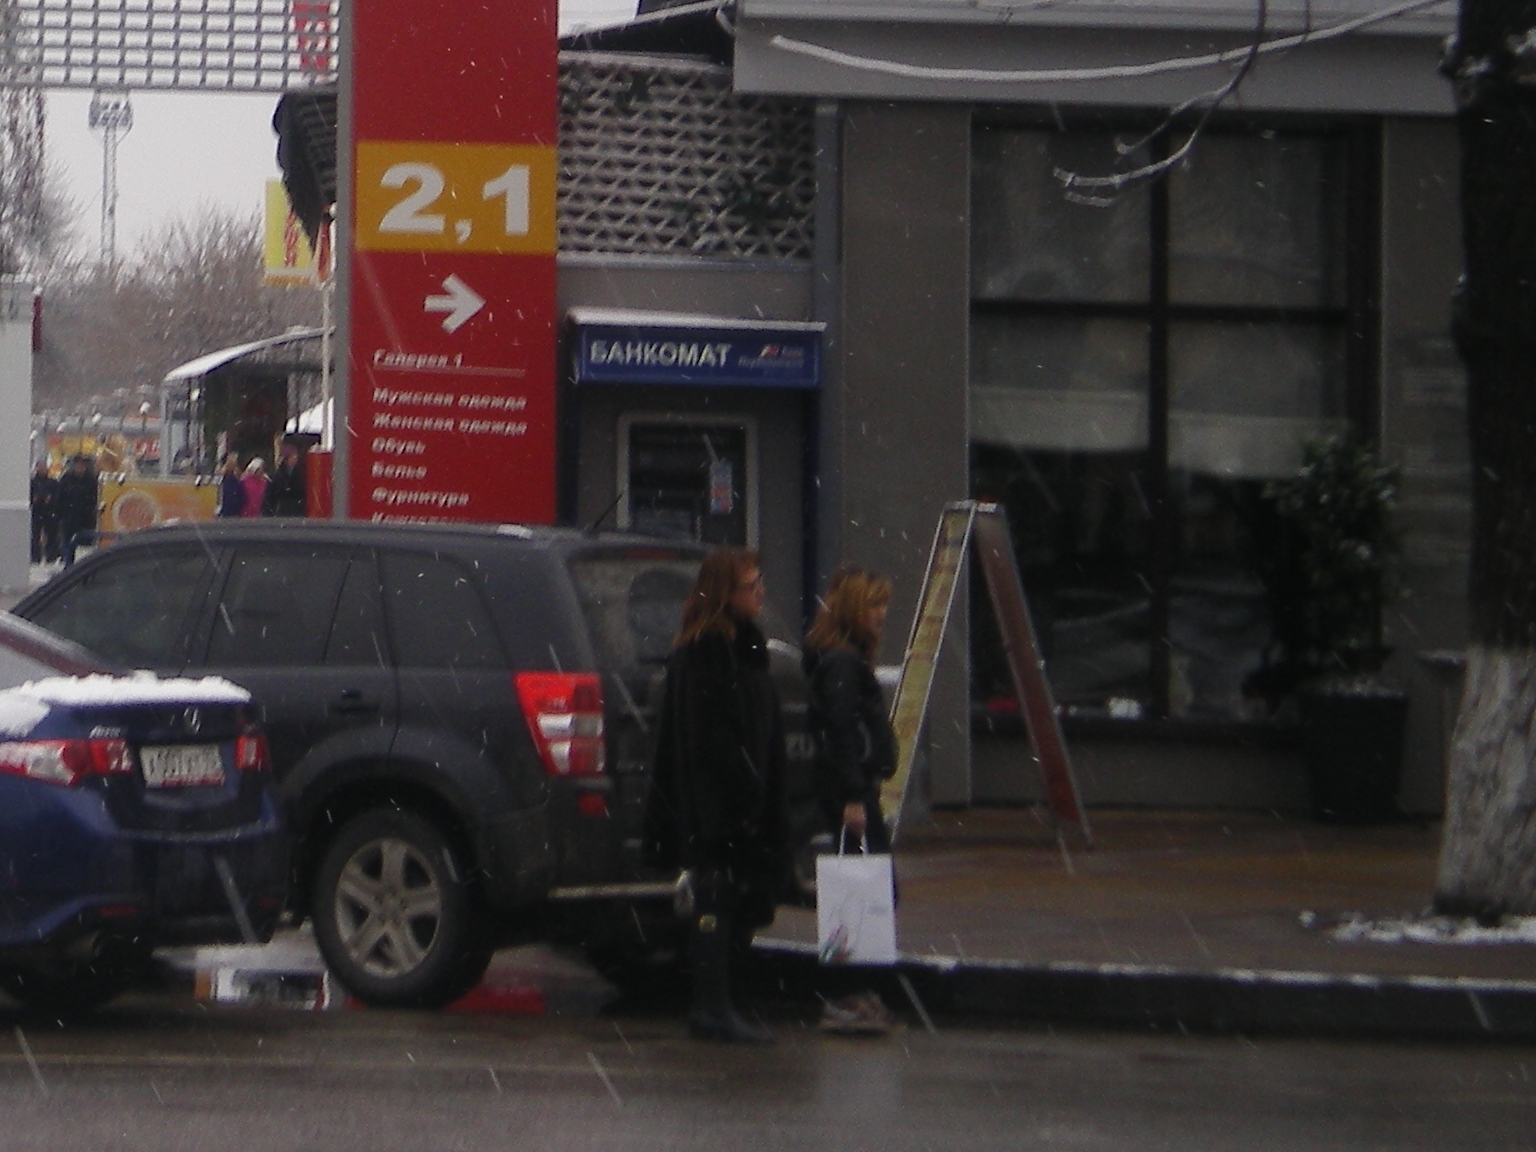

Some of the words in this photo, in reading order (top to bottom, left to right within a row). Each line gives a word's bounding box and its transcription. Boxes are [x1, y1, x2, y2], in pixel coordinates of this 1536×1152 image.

[378, 161, 531, 245] 2,1
[373, 348, 449, 368] Галерея
[453, 352, 463, 368] 1
[590, 339, 732, 368] БАНКОМАТ
[372, 386, 455, 406] Мужская
[458, 394, 528, 412] одежда
[372, 412, 455, 432] Женская
[458, 419, 528, 437] одежда
[371, 436, 426, 455] Обувь
[371, 486, 470, 508] Фурнитура
